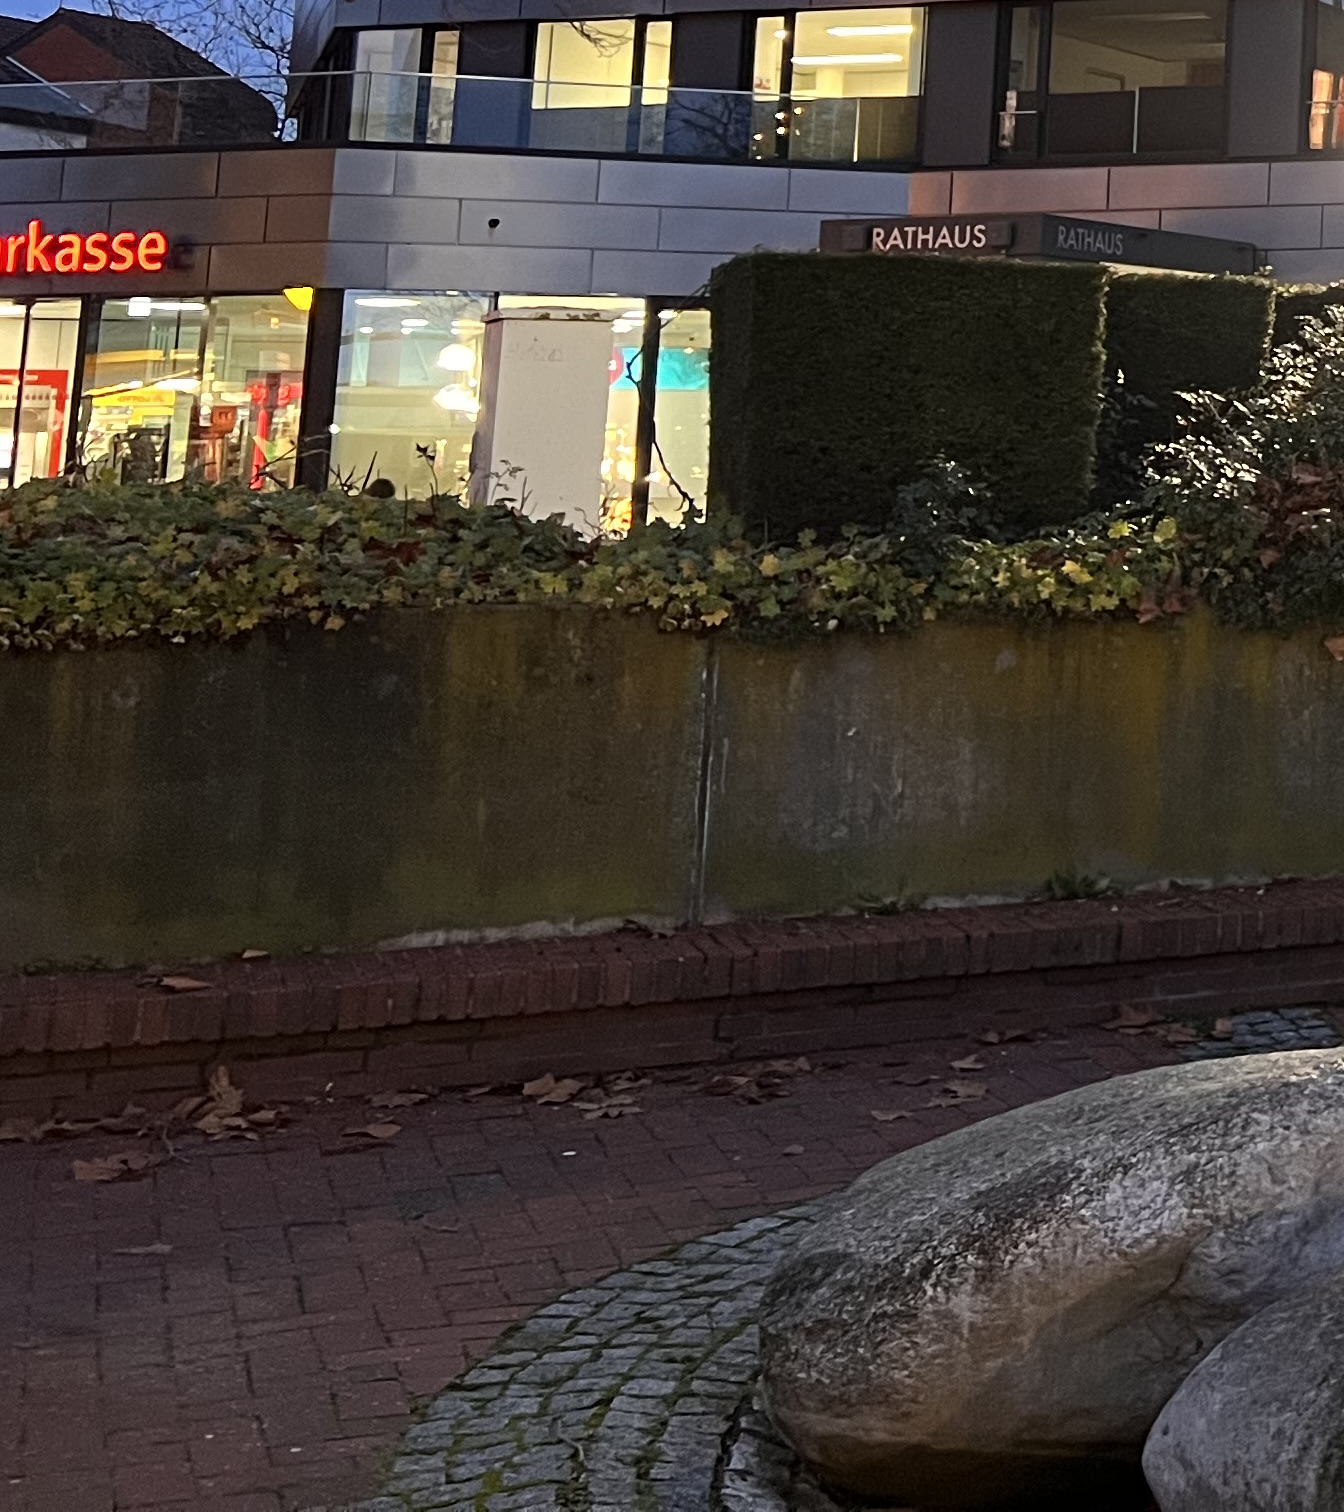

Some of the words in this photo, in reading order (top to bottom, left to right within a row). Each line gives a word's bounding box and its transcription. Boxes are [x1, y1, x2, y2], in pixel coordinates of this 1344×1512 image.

[0, 220, 167, 273] rkasse
[872, 224, 986, 251] RATHAUS
[1057, 225, 1123, 256] RATHAUS
